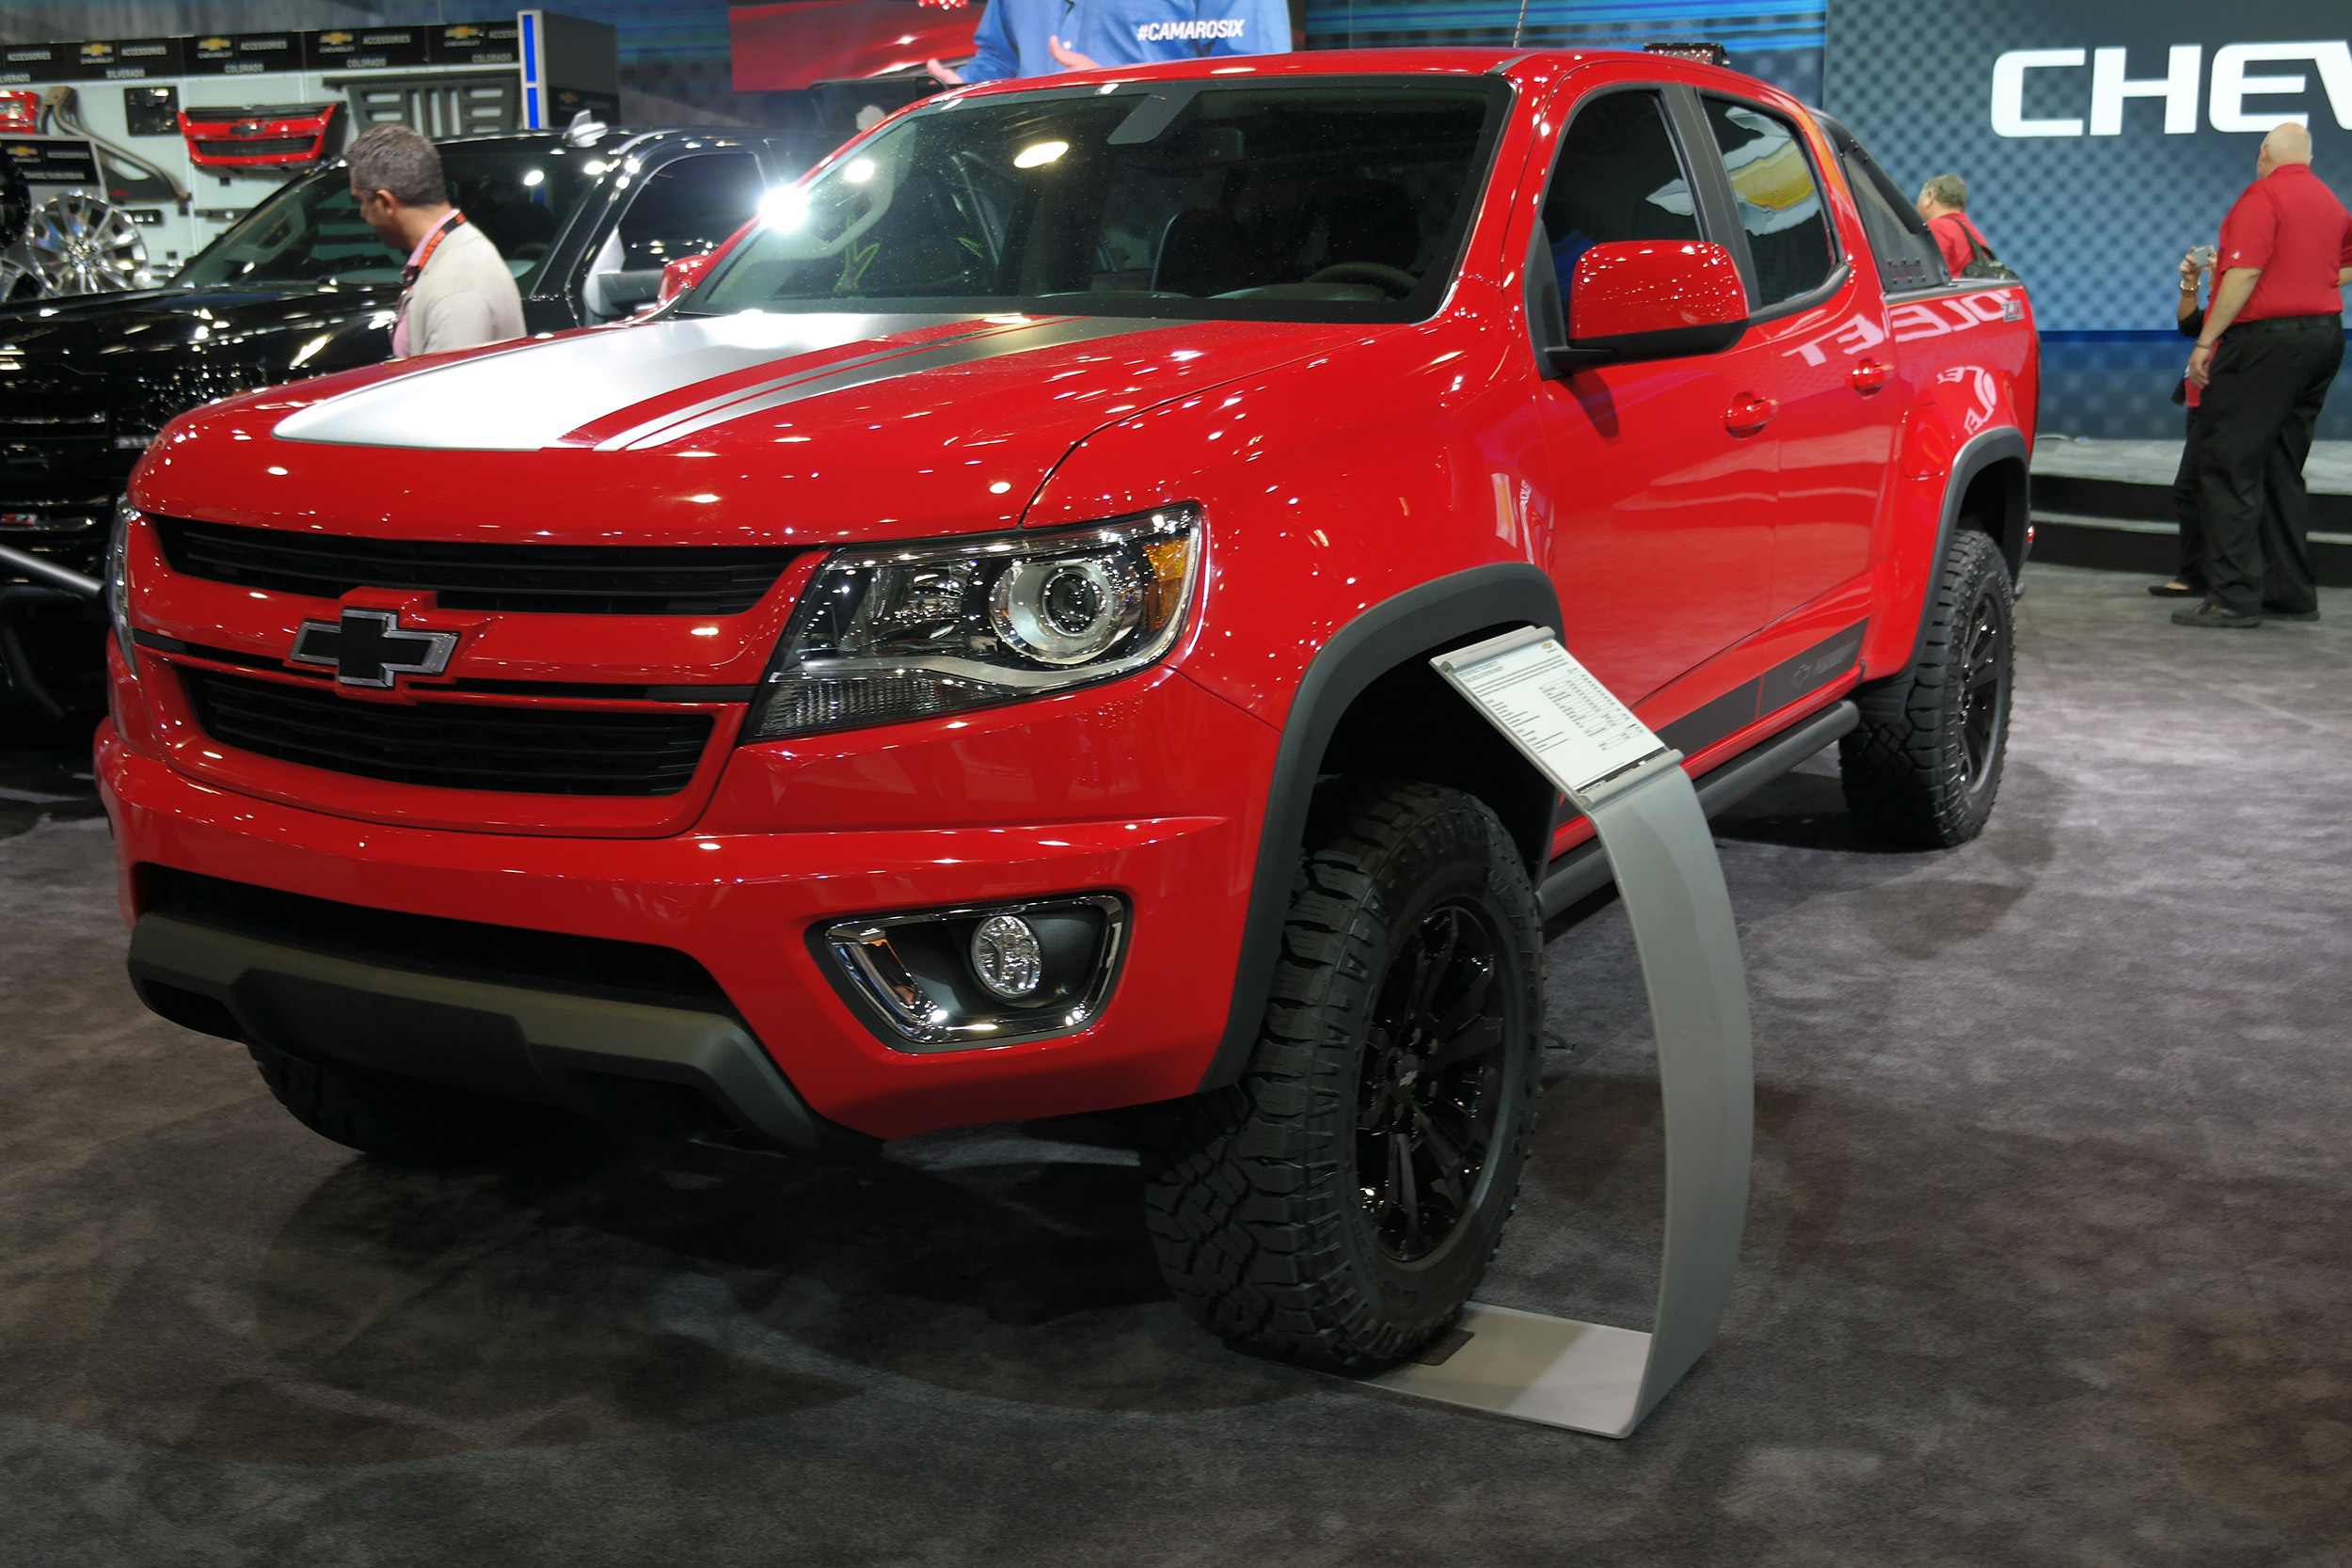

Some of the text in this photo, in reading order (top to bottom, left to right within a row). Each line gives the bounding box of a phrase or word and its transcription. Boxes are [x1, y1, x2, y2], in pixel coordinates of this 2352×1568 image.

[1136, 19, 1245, 41] #CAMAROSIX
[362, 33, 412, 45] ACCESSORIES
[345, 56, 388, 69] COLORADO
